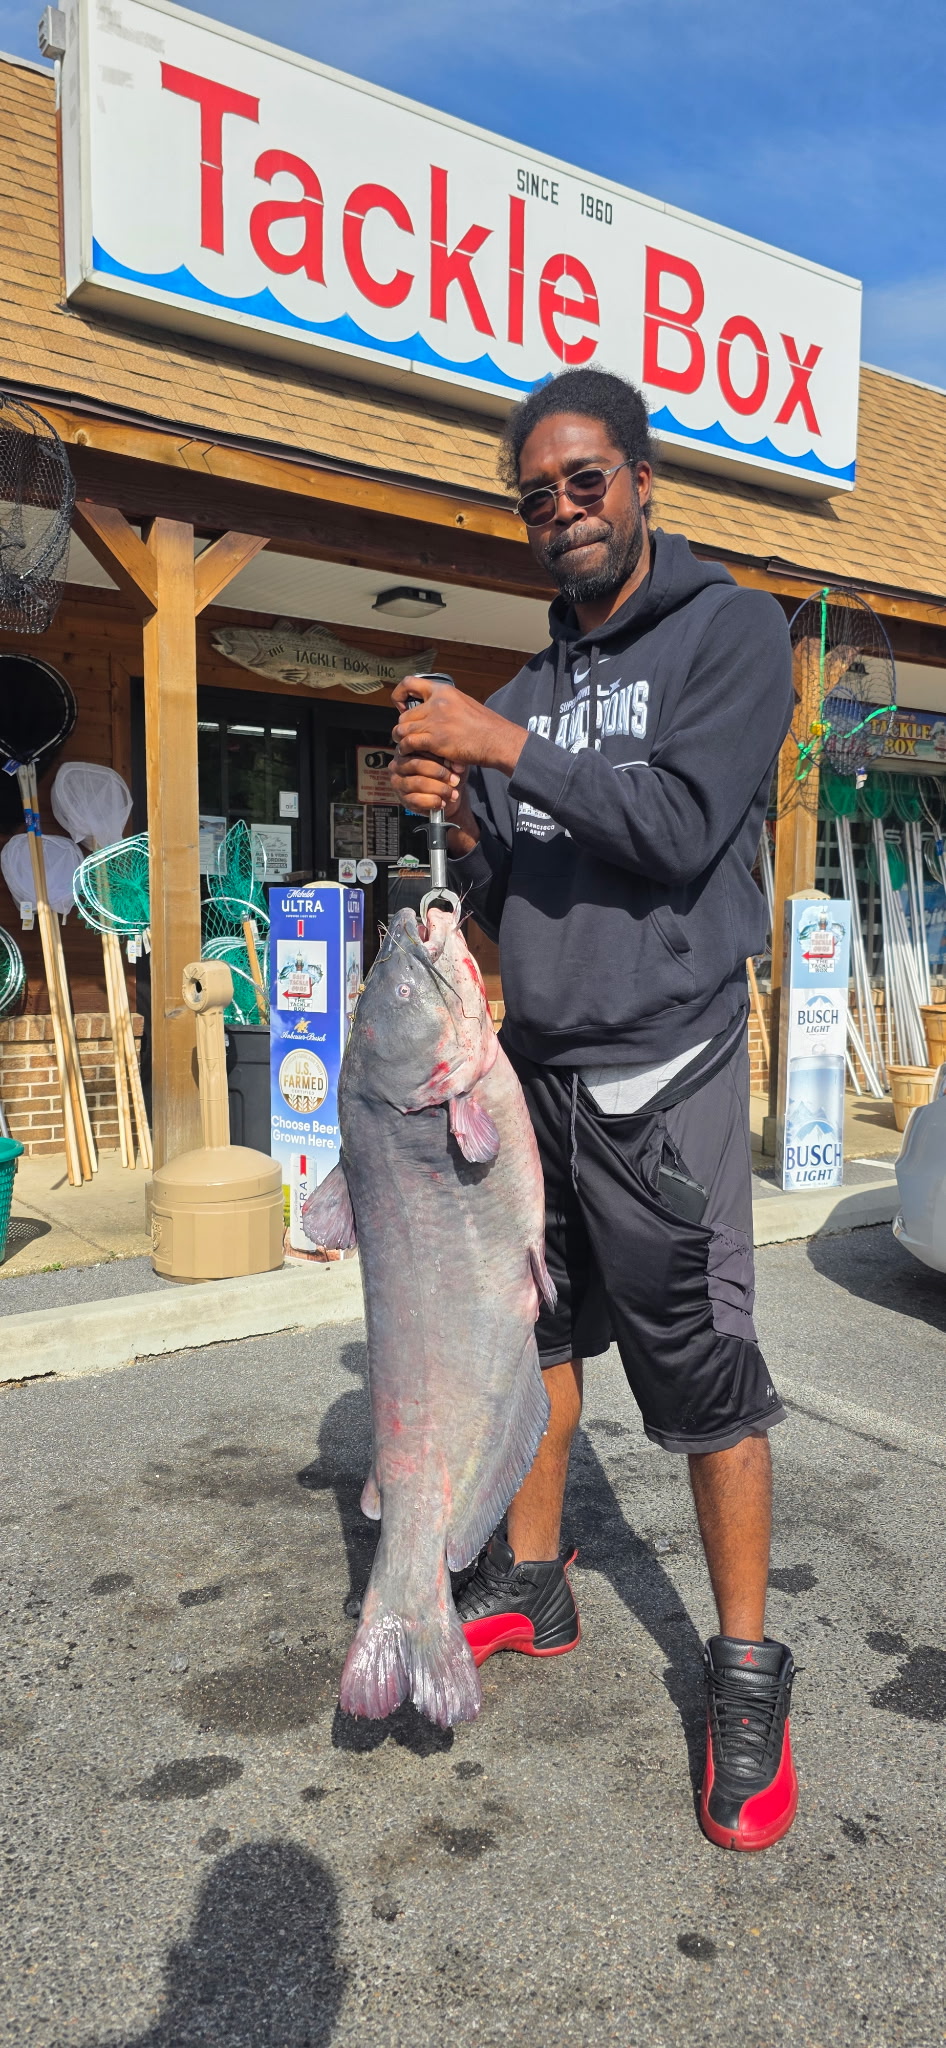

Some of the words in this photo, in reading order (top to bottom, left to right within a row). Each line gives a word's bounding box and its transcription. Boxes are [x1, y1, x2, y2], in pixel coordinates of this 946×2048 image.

[517, 168, 559, 205] SINCE
[580, 192, 613, 225] 1960
[160, 61, 600, 365] Tackle
[642, 245, 822, 437] Box
[268, 644, 286, 658] THE
[296, 649, 338, 669] TACKLE
[343, 657, 370, 675] BOX
[377, 664, 396, 679] INC
[870, 719, 933, 741] TACKLE
[884, 739, 918, 756] BOX
[286, 889, 316, 899] Michelob
[281, 899, 325, 913] ULTRA
[797, 1009, 839, 1025] BUSCH
[280, 1030, 327, 1042] Anheuser-Busch
[806, 1025, 831, 1033] LIGHT
[295, 1061, 312, 1076] U.S.
[283, 1074, 324, 1091] FARMED
[271, 1115, 311, 1132] Choose
[312, 1120, 339, 1135] Beer
[272, 1128, 306, 1145] Grown
[308, 1133, 337, 1149] Here.
[786, 1143, 842, 1170] BUSCH
[796, 1168, 834, 1182] LIGHT
